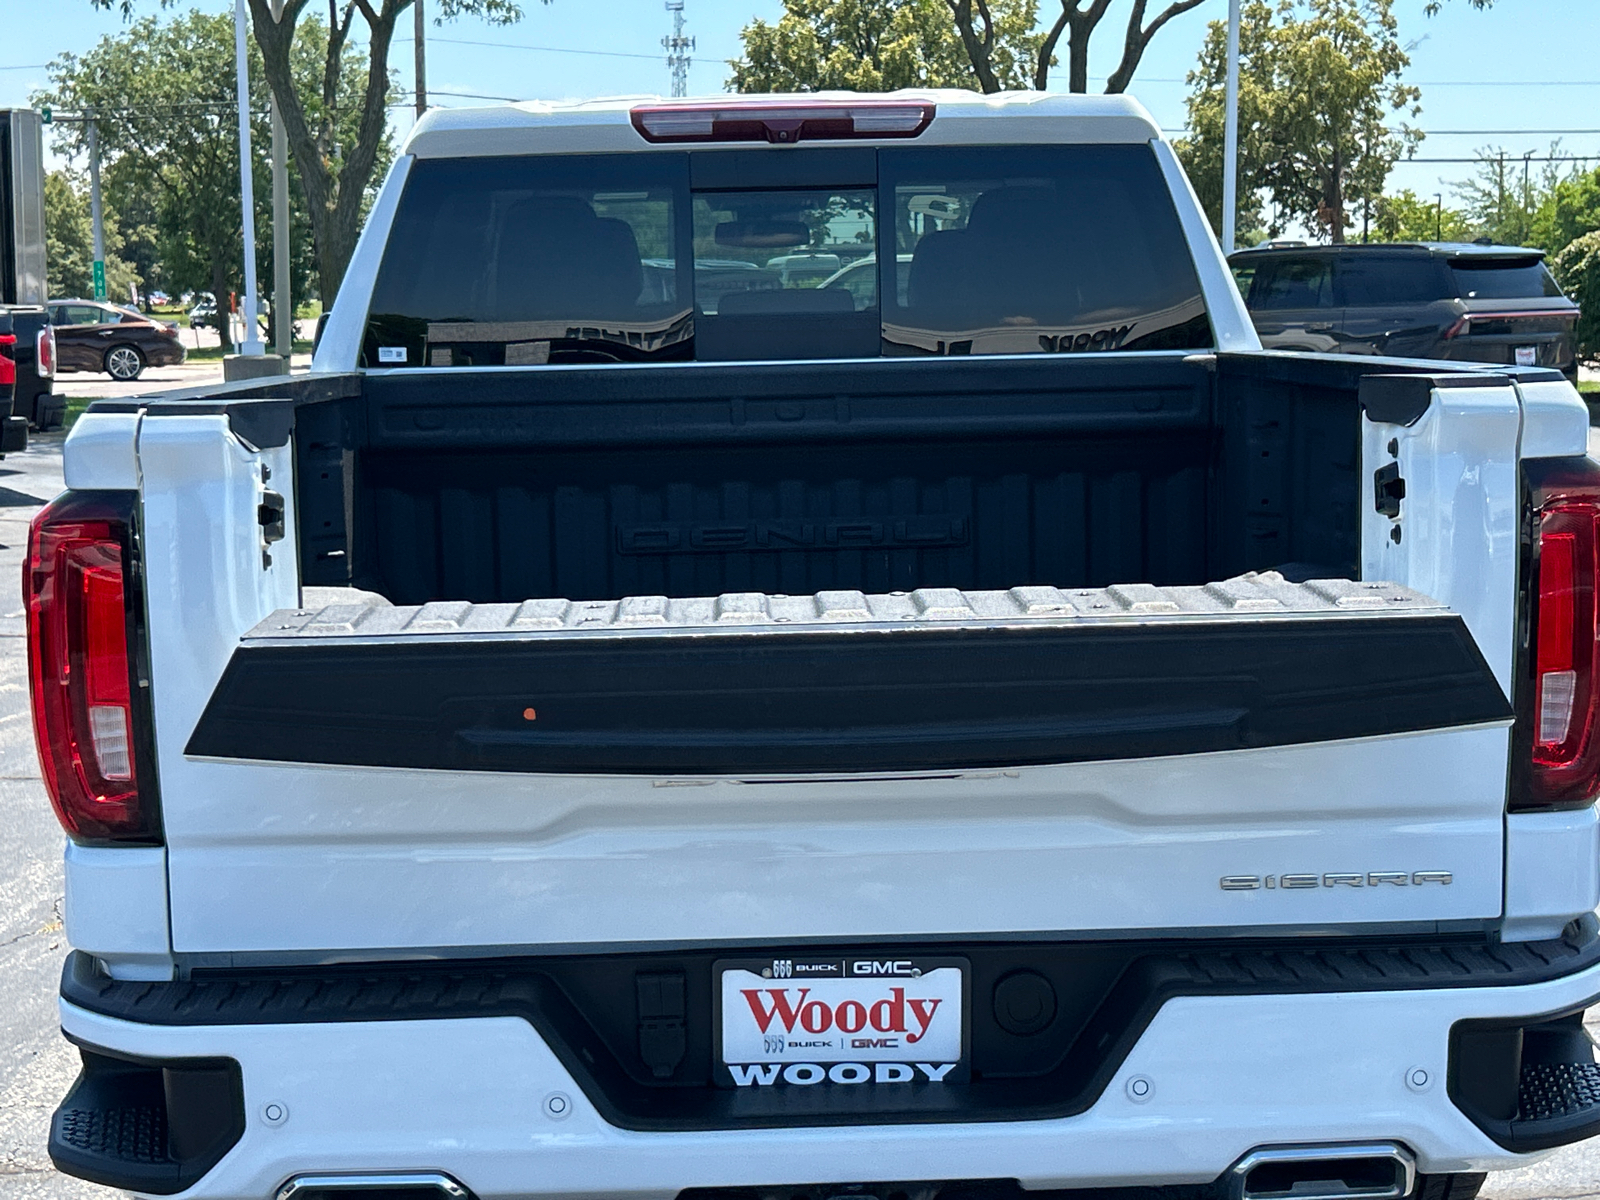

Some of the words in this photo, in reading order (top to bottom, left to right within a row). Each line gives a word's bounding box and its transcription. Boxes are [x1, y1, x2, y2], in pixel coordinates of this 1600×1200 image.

[1220, 870, 1453, 891] SIERRA
[796, 963, 838, 972] BUICK
[853, 960, 912, 974] GMC
[739, 987, 943, 1044] Woody
[787, 1040, 833, 1048] BUICK
[851, 1038, 899, 1049] GMC
[727, 1063, 957, 1086] WOODY
